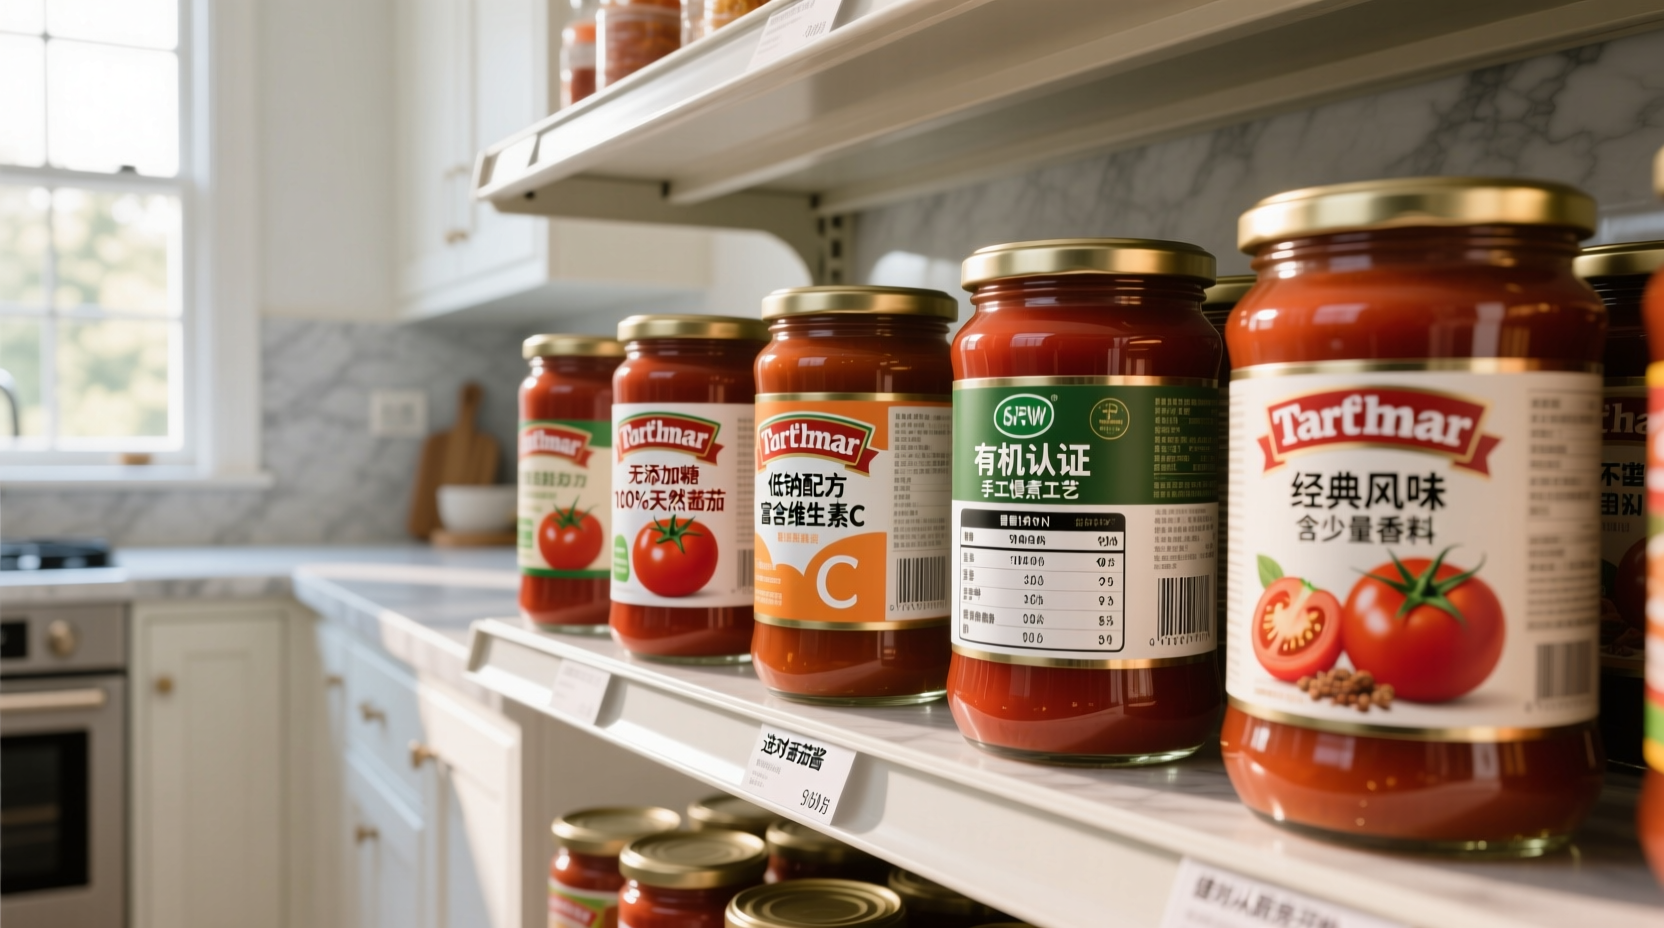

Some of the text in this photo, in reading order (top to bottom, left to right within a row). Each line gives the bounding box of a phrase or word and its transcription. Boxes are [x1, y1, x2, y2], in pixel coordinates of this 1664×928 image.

[628, 464, 699, 485] 无添加糖
[974, 442, 1091, 477] 有机认证
[768, 472, 847, 498] 低钠配方
[1291, 471, 1447, 511] 经典风味
[1296, 514, 1435, 545] 含少量香料
[816, 554, 859, 609] C
